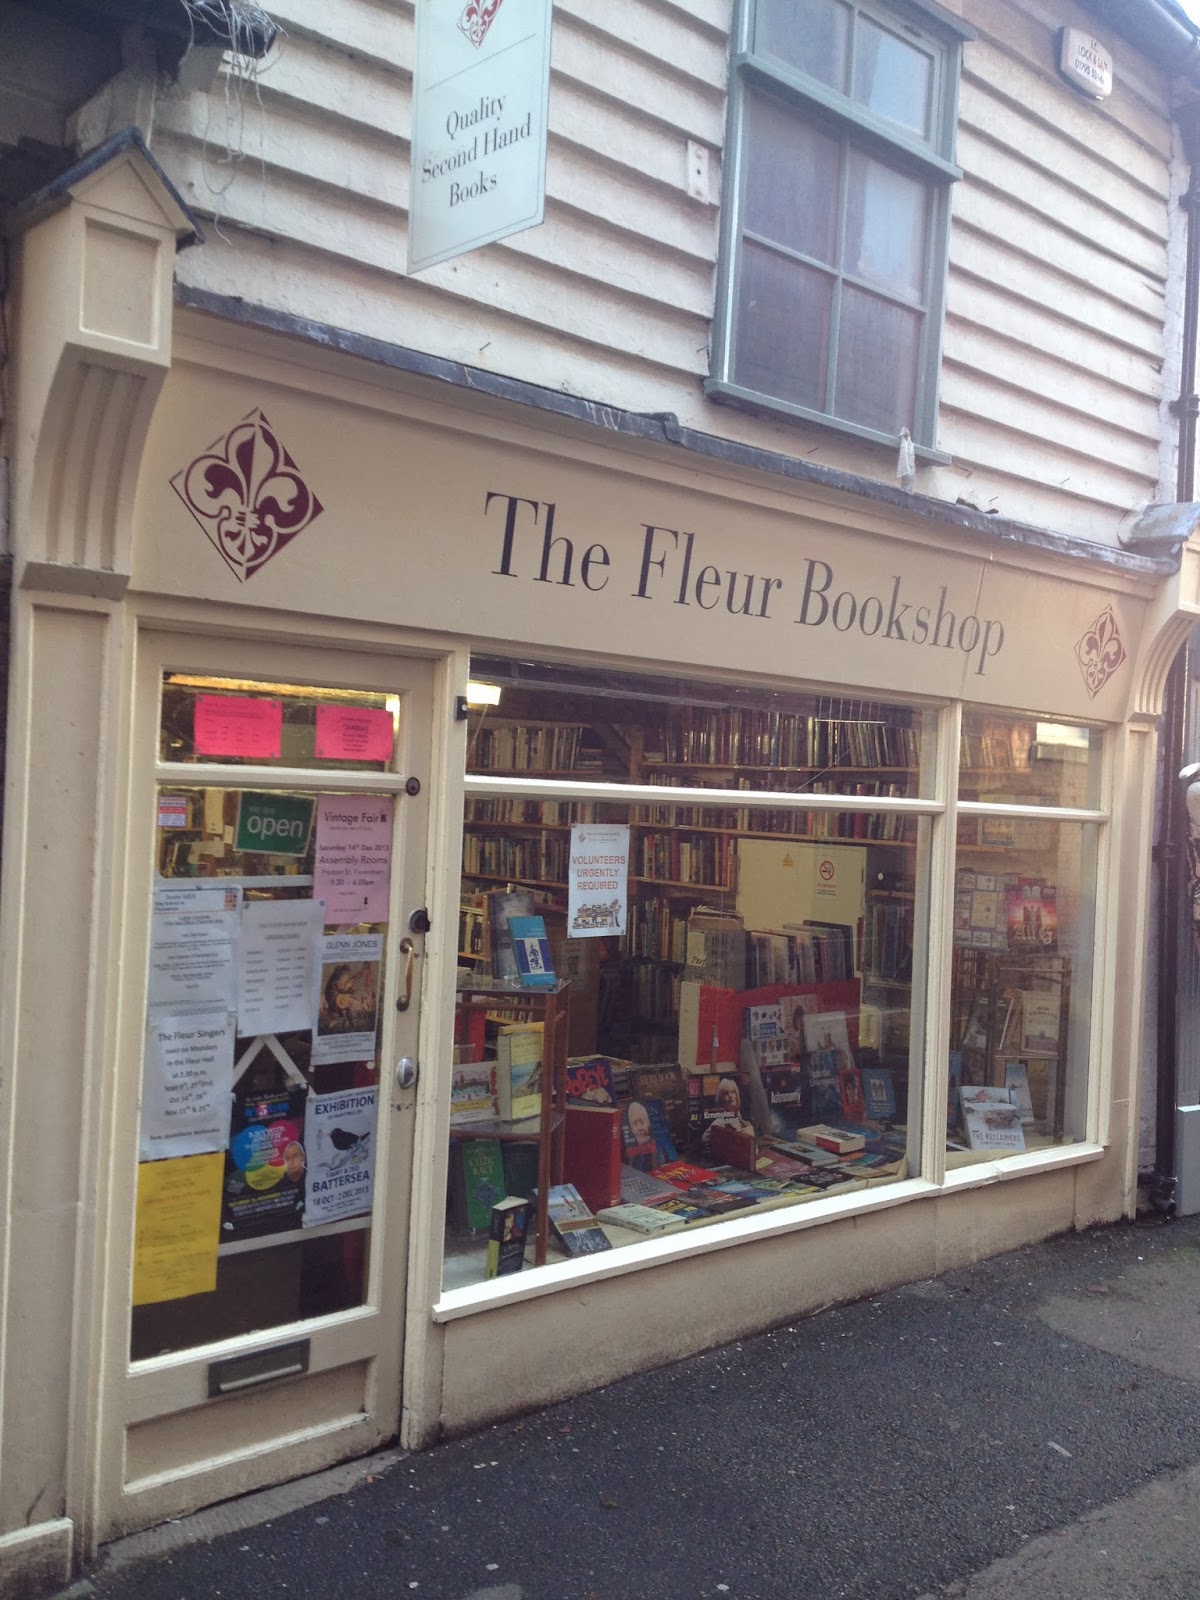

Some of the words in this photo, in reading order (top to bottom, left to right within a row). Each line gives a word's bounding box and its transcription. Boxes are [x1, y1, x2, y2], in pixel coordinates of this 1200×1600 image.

[446, 95, 506, 139] Quality
[422, 138, 477, 183] Second
[484, 113, 531, 155] Hand
[449, 172, 497, 207] Books
[484, 491, 611, 592] The
[630, 523, 784, 619] Fleur
[794, 557, 1005, 676] Bookshop
[324, 812, 358, 825] Vintage
[361, 812, 380, 823] Fair
[247, 815, 303, 840] open
[319, 856, 358, 866] Assembly
[360, 855, 388, 864] Rooms
[572, 855, 626, 865] VOLUNTEERS
[576, 868, 620, 877] URGENTLY
[576, 881, 619, 890] REQUIRED
[326, 941, 351, 950] GLENN
[352, 940, 378, 948] JONES
[157, 1033, 172, 1042] The
[174, 1031, 195, 1040] Fleur
[197, 1029, 226, 1039] Singers
[770, 1091, 801, 1104] Astronomy
[315, 1094, 375, 1115] EXHIBITION
[703, 1111, 735, 1120] Emmylou
[985, 1133, 1021, 1142] RECLAIMERS
[312, 1170, 370, 1193] BATTERSEA
[321, 1194, 334, 1205] OCT
